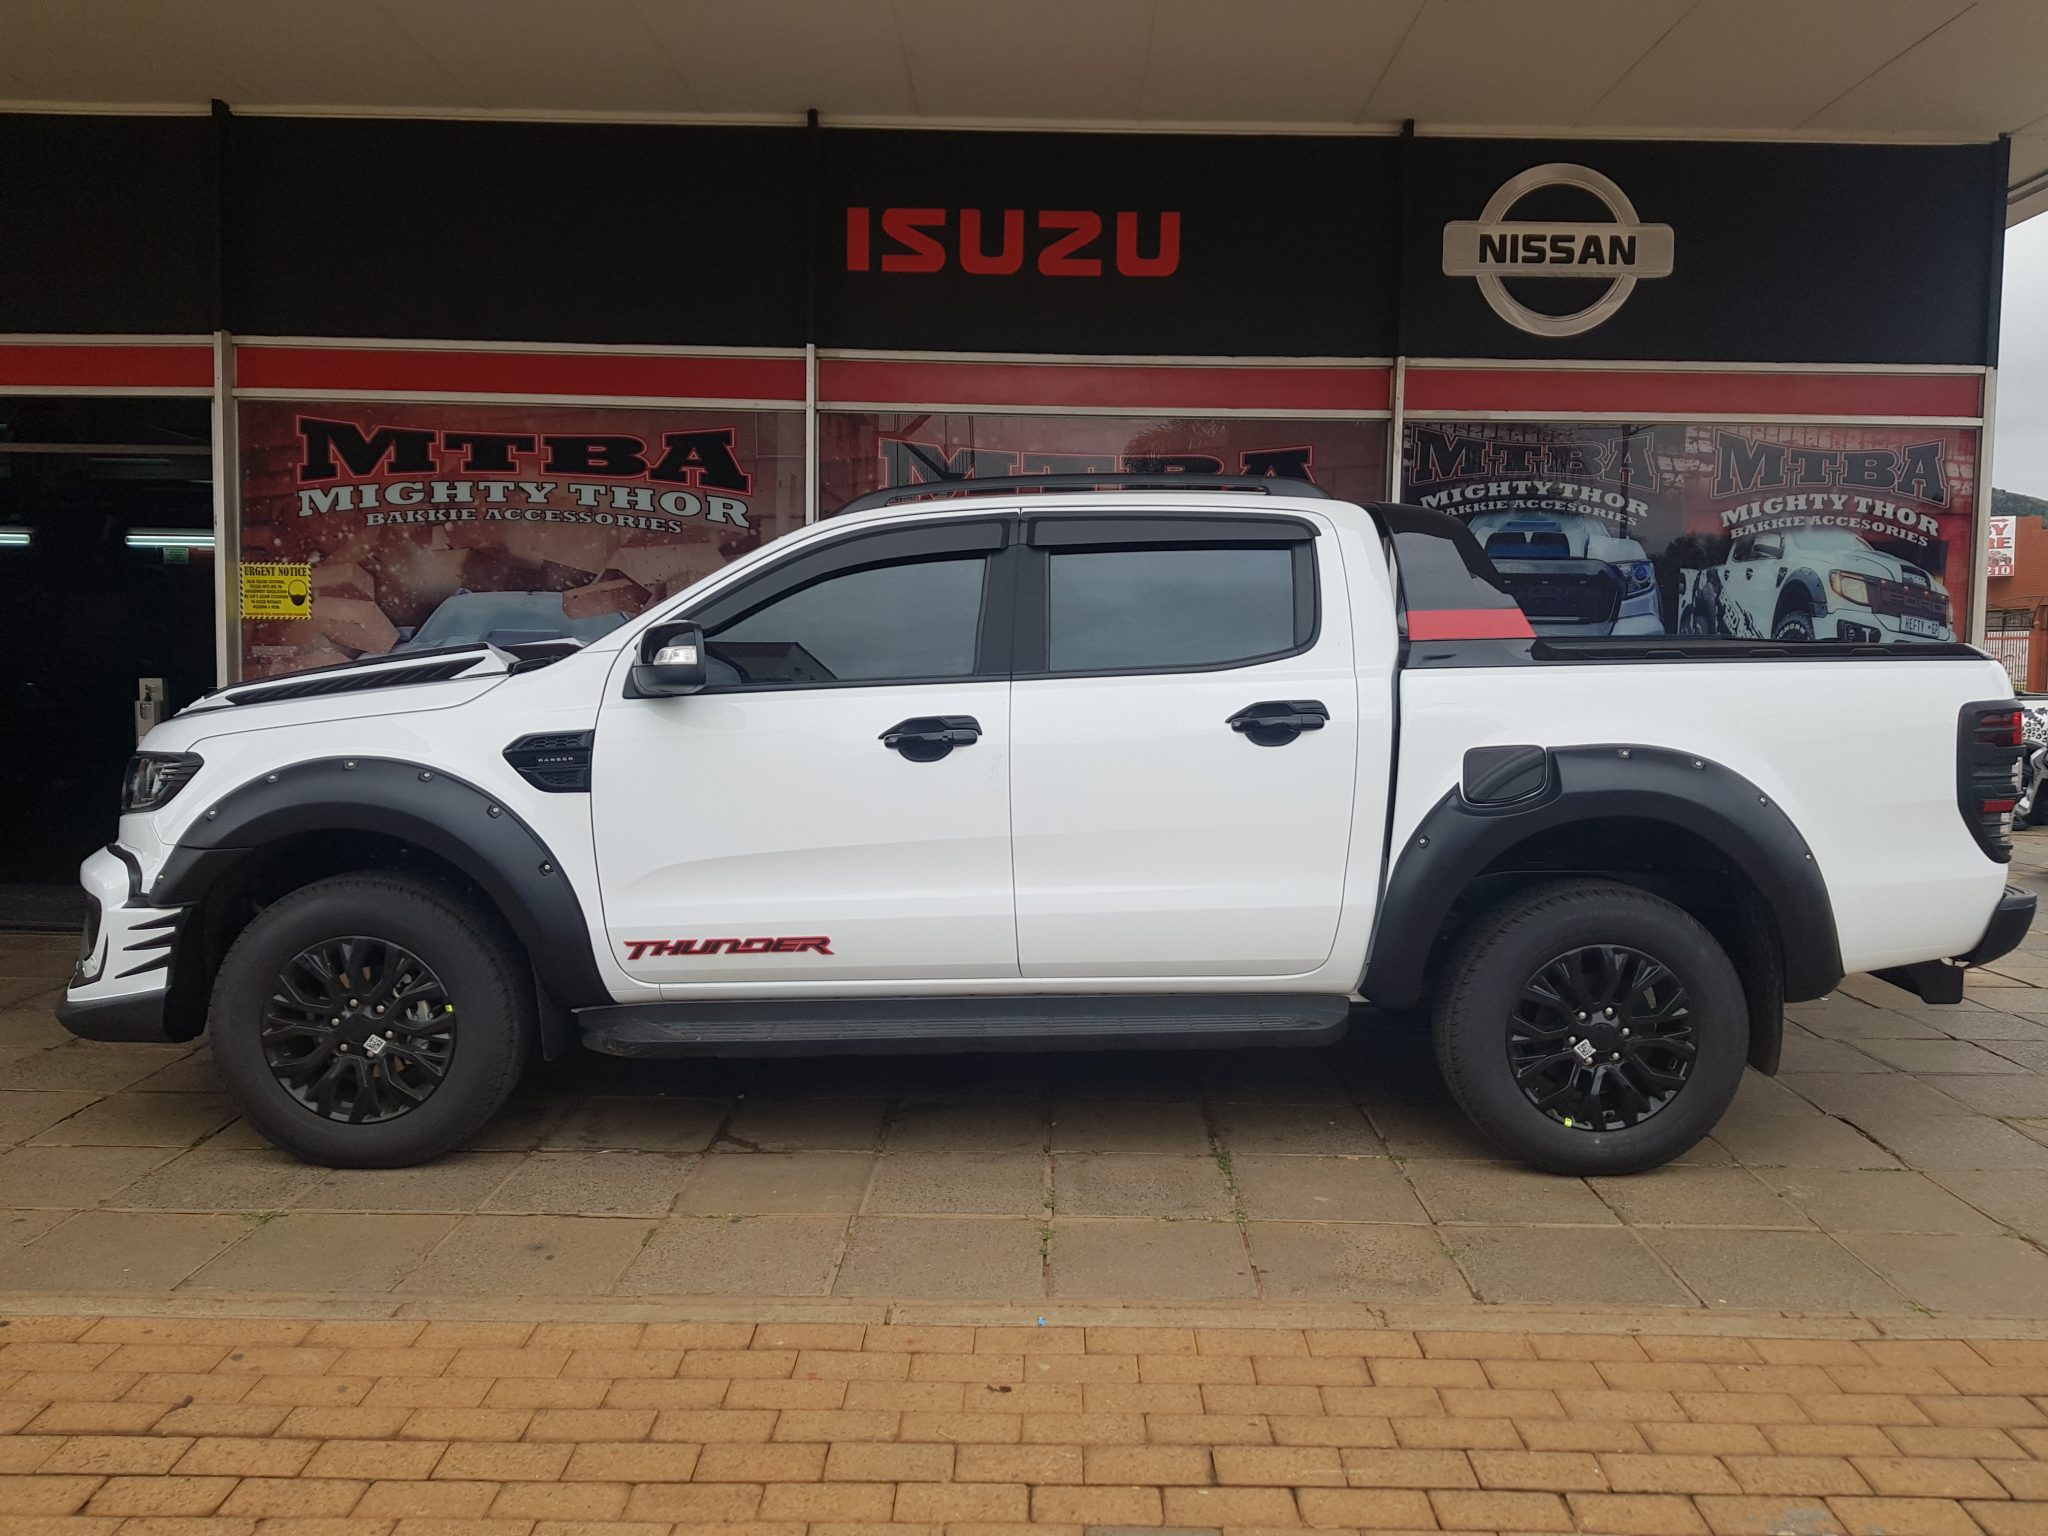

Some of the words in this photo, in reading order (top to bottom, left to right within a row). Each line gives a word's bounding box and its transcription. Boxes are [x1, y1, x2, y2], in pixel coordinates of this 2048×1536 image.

[846, 207, 1181, 277] ISUZU
[1477, 233, 1637, 267] NISSAN
[296, 414, 753, 496] MTBA
[1409, 424, 1660, 493] MTBA
[1710, 427, 1950, 508] MTBA
[297, 480, 561, 518] MIGHTY
[568, 482, 752, 530] THOR
[1420, 480, 1554, 509] MIGHTY
[1556, 482, 1649, 518] THOR
[1439, 500, 1508, 516] AKKIE
[1720, 493, 1850, 528] MIGHTY
[1854, 495, 1940, 537] THOR
[365, 506, 478, 527] BAKKIE
[482, 507, 684, 534] ACCESSORIES
[1730, 515, 1805, 540] BAKKIE
[1807, 514, 1929, 548] ACCESORIES
[244, 566, 275, 577] URGENT
[278, 566, 308, 577] NOTICE
[623, 936, 835, 960] THUNDER
